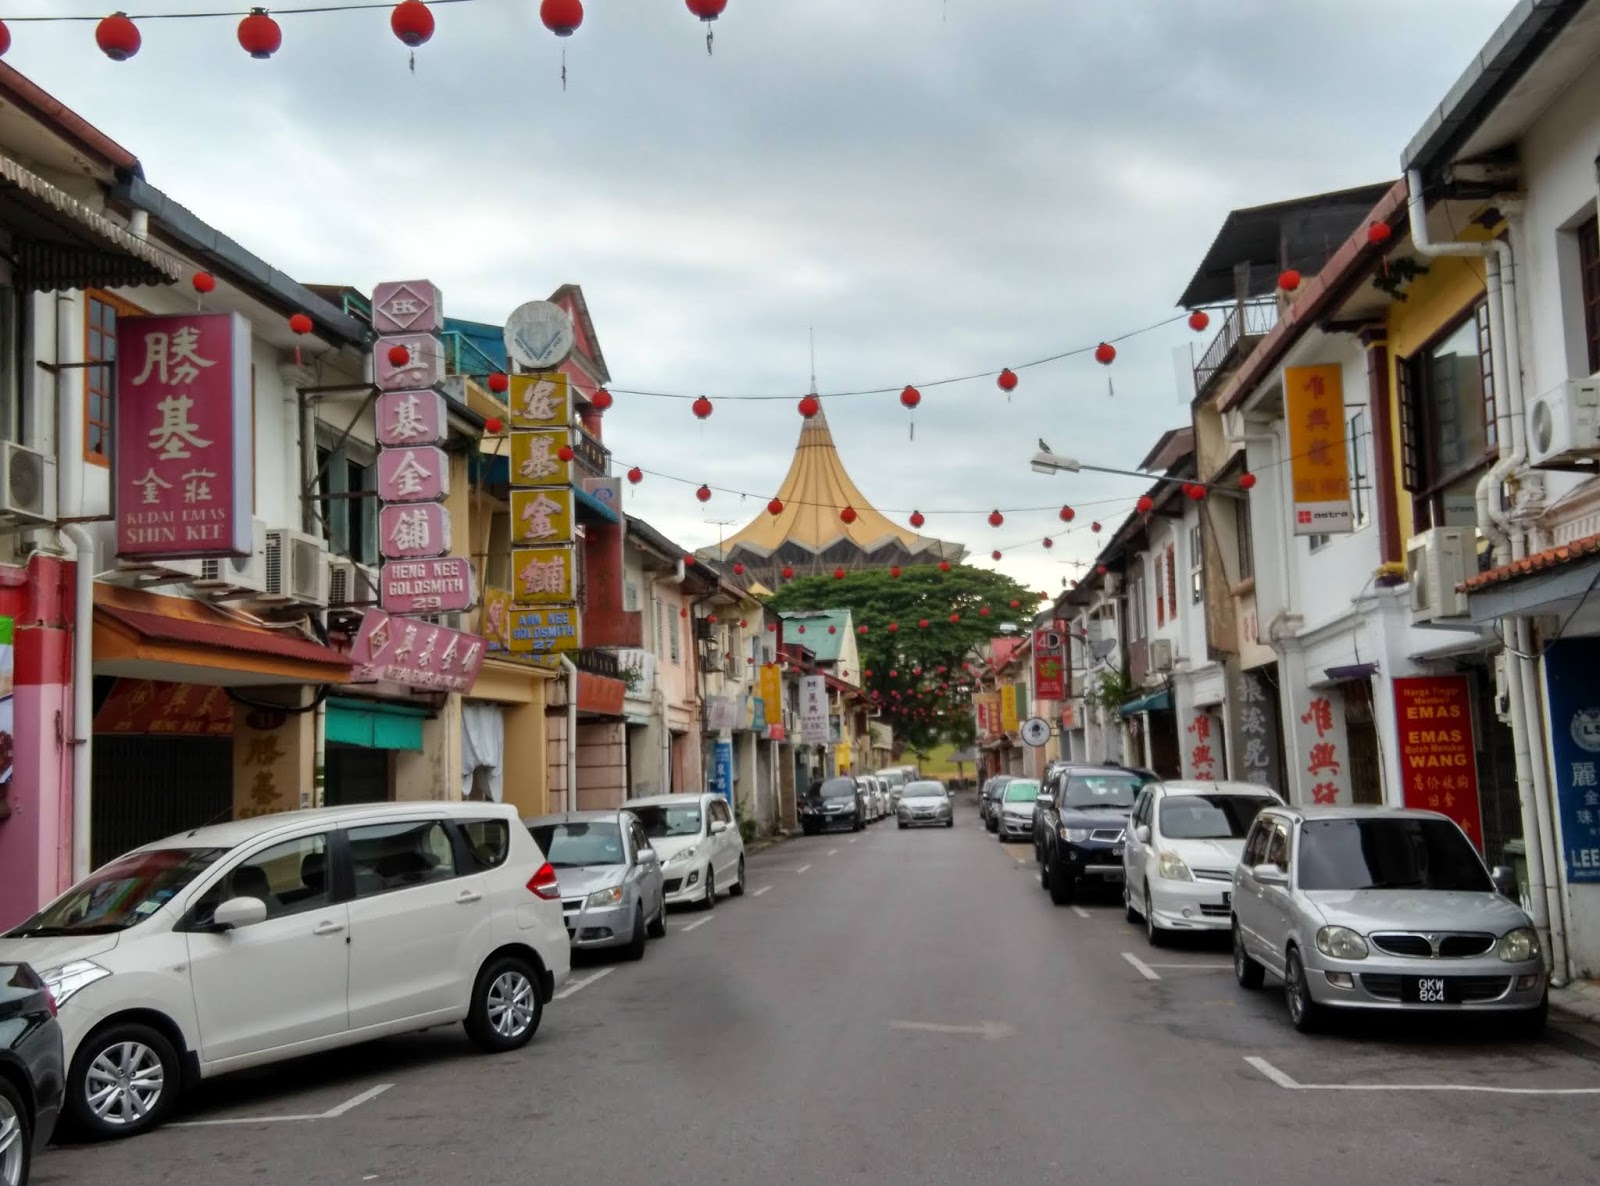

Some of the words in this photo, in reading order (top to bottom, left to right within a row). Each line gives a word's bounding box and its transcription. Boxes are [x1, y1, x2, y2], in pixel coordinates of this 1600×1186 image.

[126, 526, 176, 544] SHIN
[186, 524, 225, 540] KEE
[391, 564, 426, 579] HENG
[389, 578, 463, 596] GOLDSMITH
[411, 596, 441, 609] 29
[513, 625, 575, 640] GOLDSMITH
[532, 640, 556, 650] 27
[1037, 632, 1060, 650] 4D
[1407, 705, 1461, 720] EMAS
[1408, 729, 1462, 744] EMAS
[1409, 753, 1468, 768] WANG
[1571, 849, 1600, 868] LEE
[1419, 990, 1444, 1002] 864
